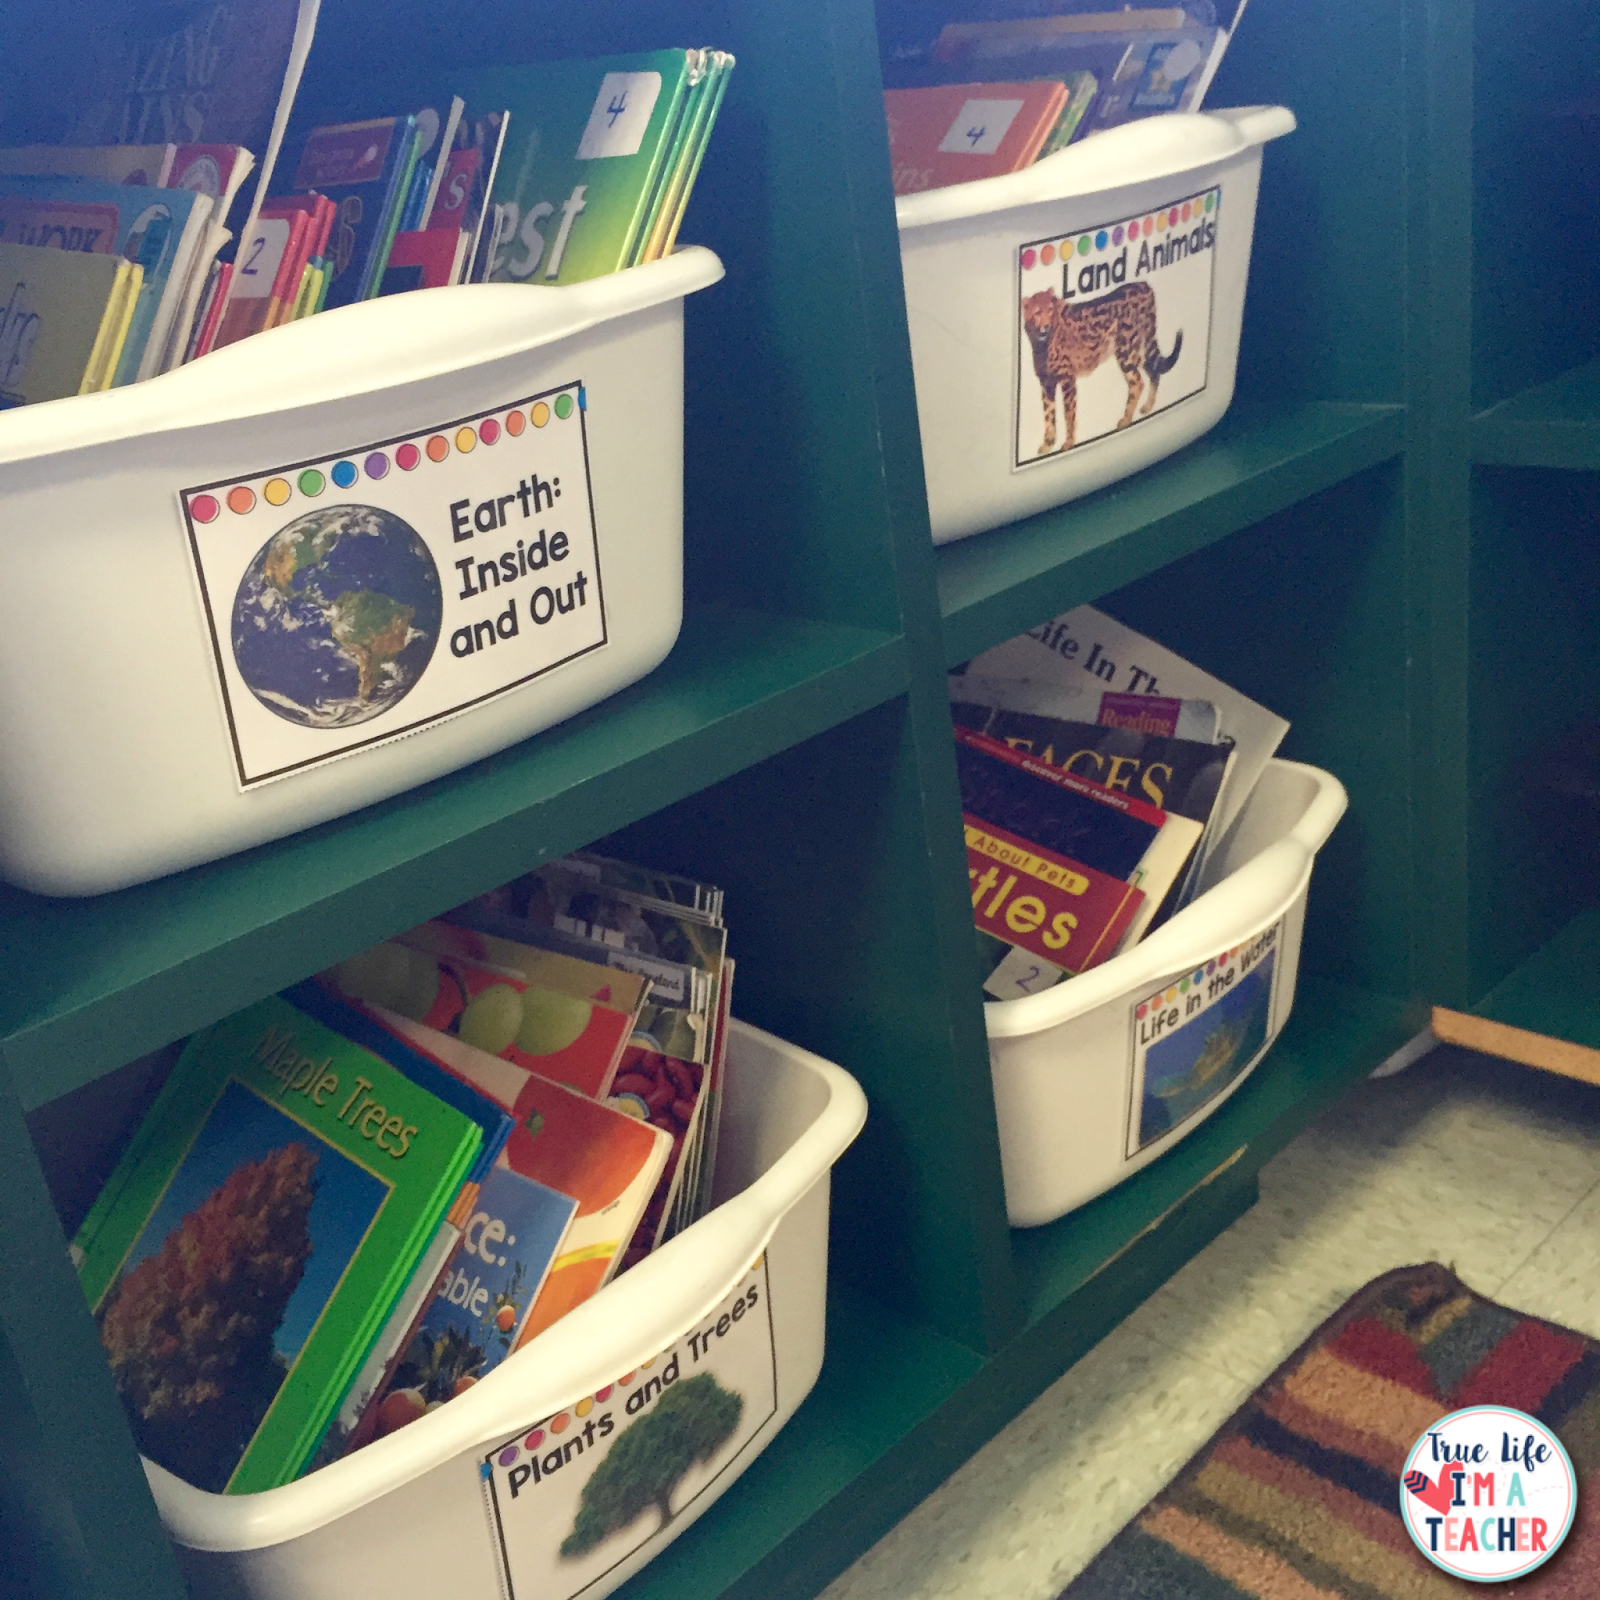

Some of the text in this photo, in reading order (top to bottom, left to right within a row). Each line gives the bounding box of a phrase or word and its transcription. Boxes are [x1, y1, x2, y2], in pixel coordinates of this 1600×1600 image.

[606, 90, 627, 128] 4
[966, 127, 986, 147] 4
[242, 237, 266, 275] 2
[1062, 217, 1216, 299] Land Animals
[450, 474, 561, 543] Earth:
[455, 529, 570, 600] Inside
[450, 571, 588, 658] and Out
[1083, 642, 1117, 682] In
[1006, 737, 1173, 809] CES
[974, 835, 1077, 889] About Pets
[968, 866, 1079, 949] tles
[1141, 921, 1280, 1045] Life in the Water
[255, 1022, 419, 1160] Maple Trees
[508, 1284, 759, 1499] Plants and Trees
